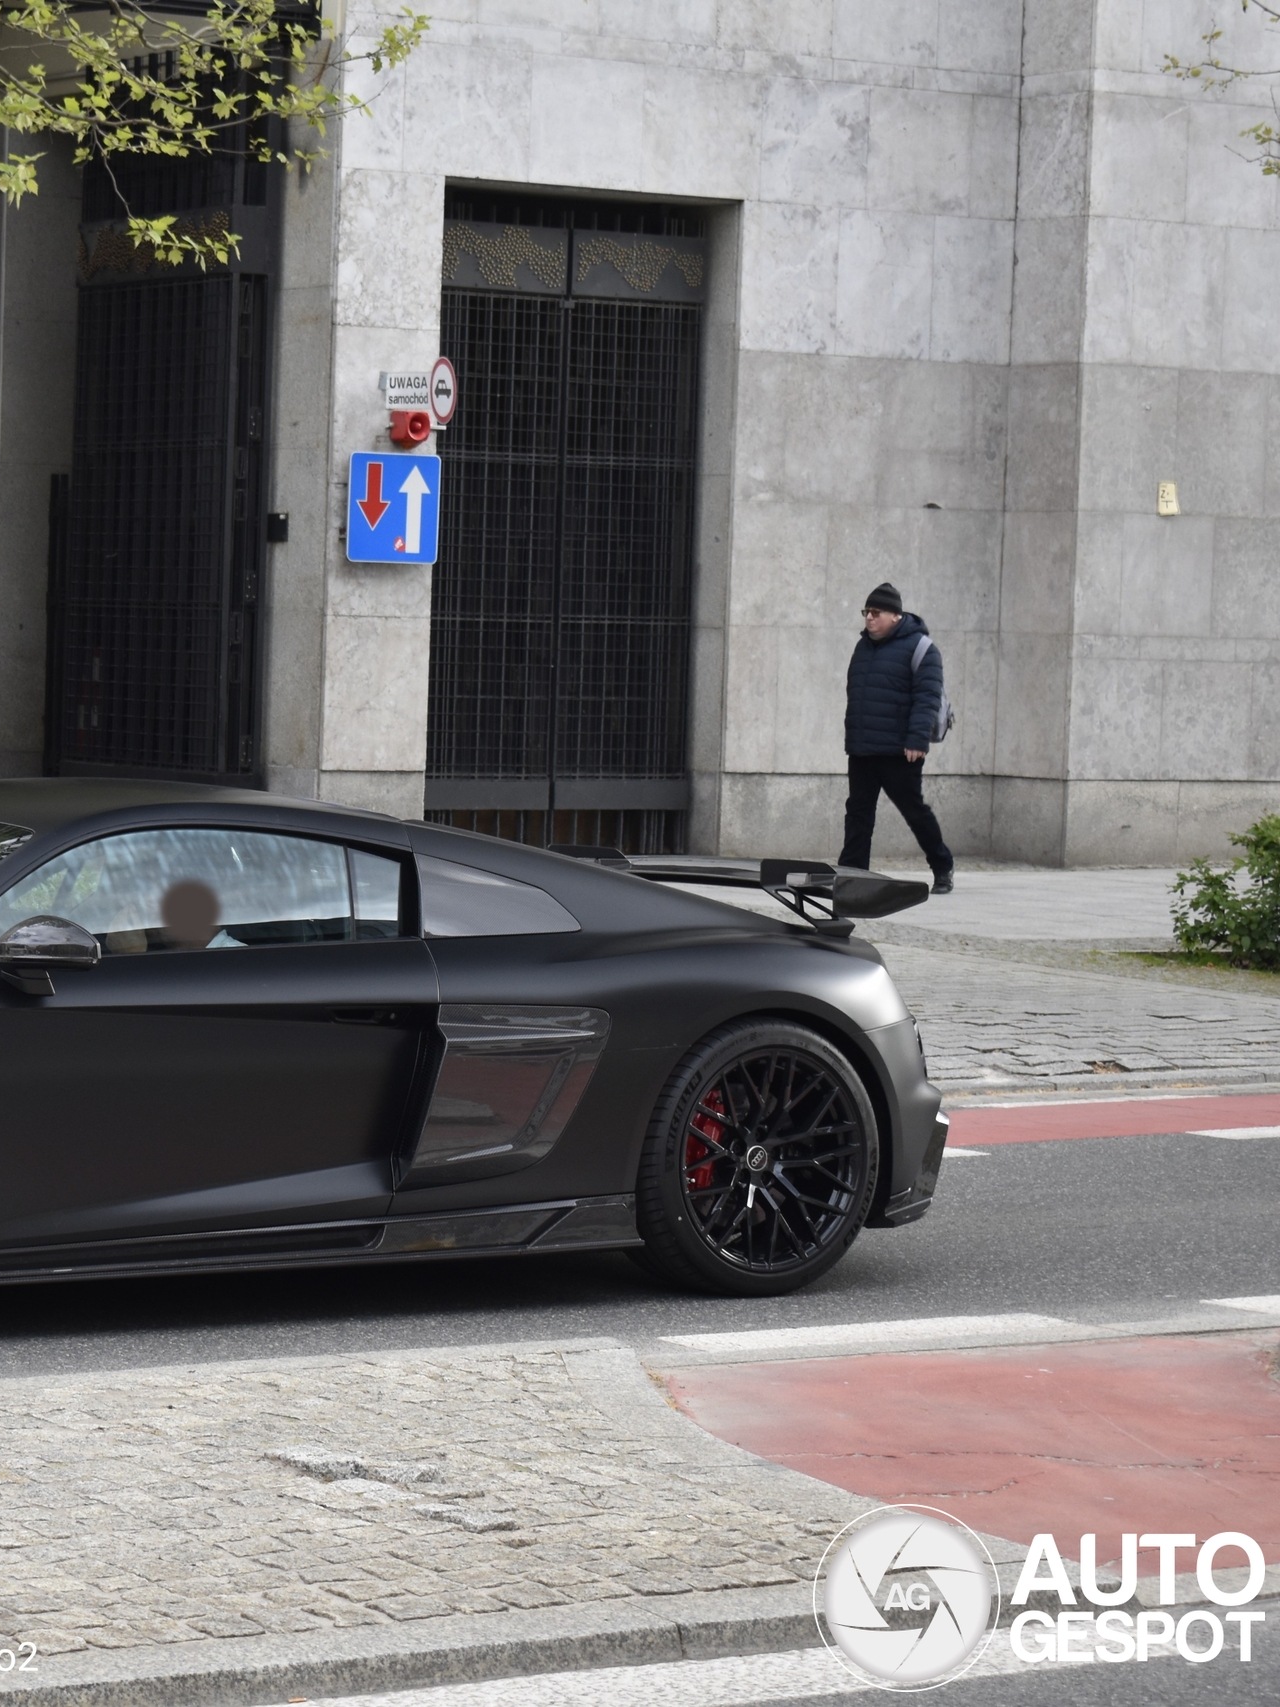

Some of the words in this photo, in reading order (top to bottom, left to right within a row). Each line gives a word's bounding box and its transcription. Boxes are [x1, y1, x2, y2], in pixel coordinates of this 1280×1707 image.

[389, 376, 428, 390] UWAGA
[388, 392, 429, 405] samochód
[667, 1073, 702, 1153] MICHELIN
